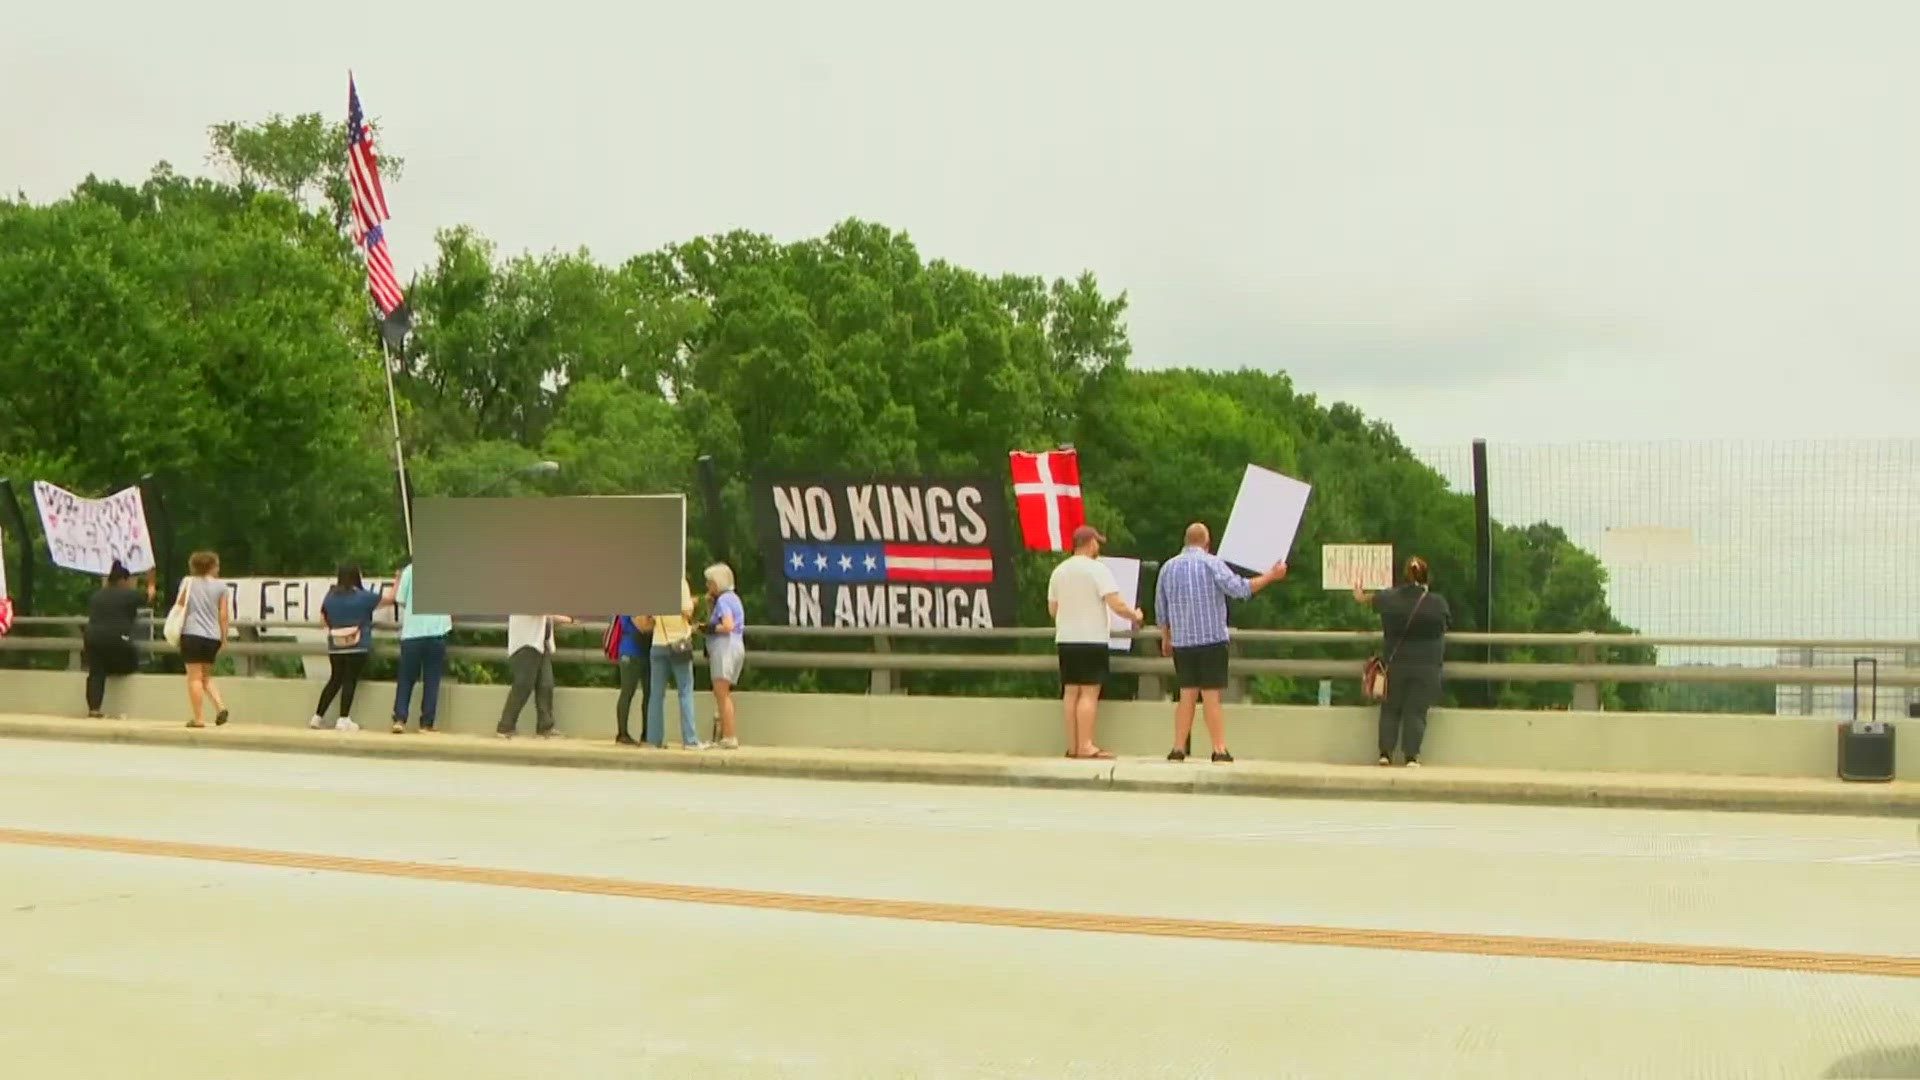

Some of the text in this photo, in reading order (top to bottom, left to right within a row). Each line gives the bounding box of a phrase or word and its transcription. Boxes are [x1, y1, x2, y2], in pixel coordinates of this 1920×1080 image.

[773, 485, 987, 544] NO KINGS
[787, 582, 993, 629] IN AMERICA
